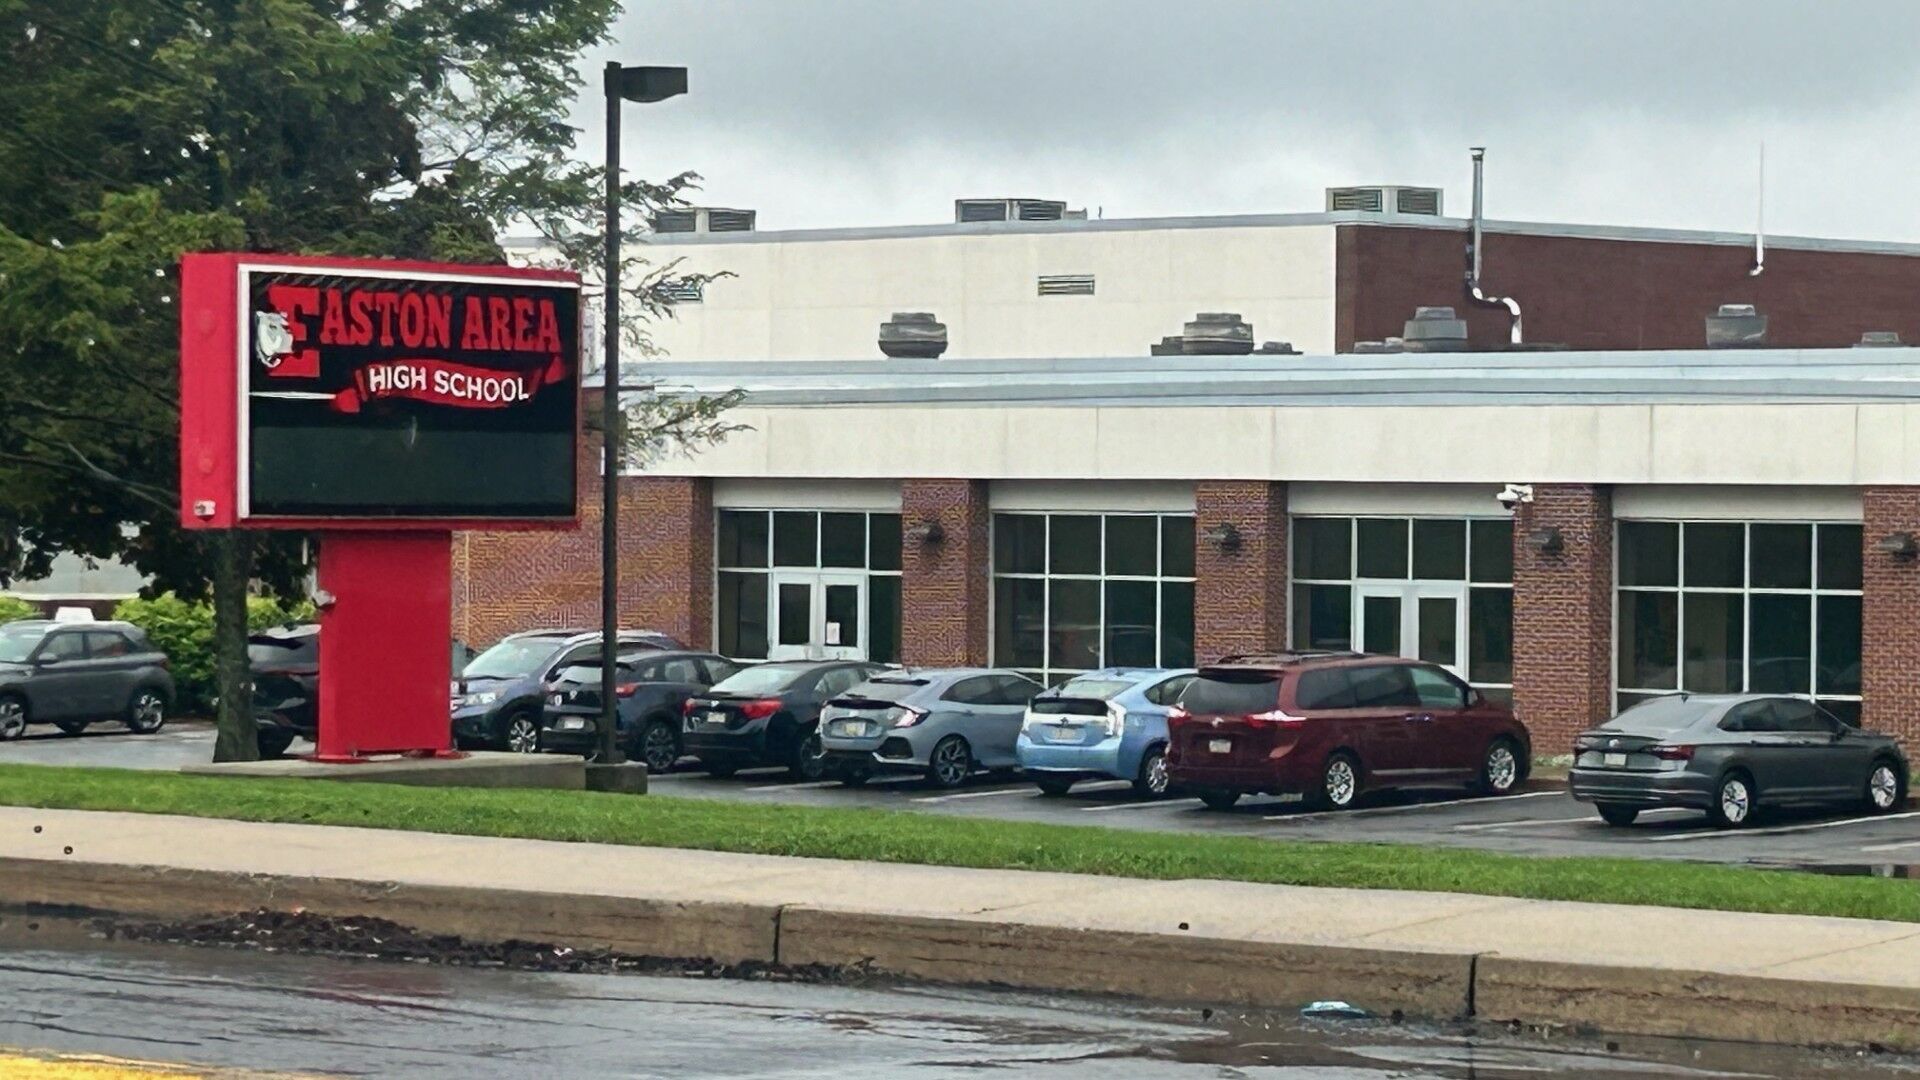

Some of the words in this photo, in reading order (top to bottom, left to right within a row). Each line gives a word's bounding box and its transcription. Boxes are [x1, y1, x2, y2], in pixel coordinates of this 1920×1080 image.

[269, 285, 451, 377] EASTON
[462, 297, 562, 353] AREA
[369, 365, 427, 392] HIGH
[433, 370, 530, 402] SCHOOL
